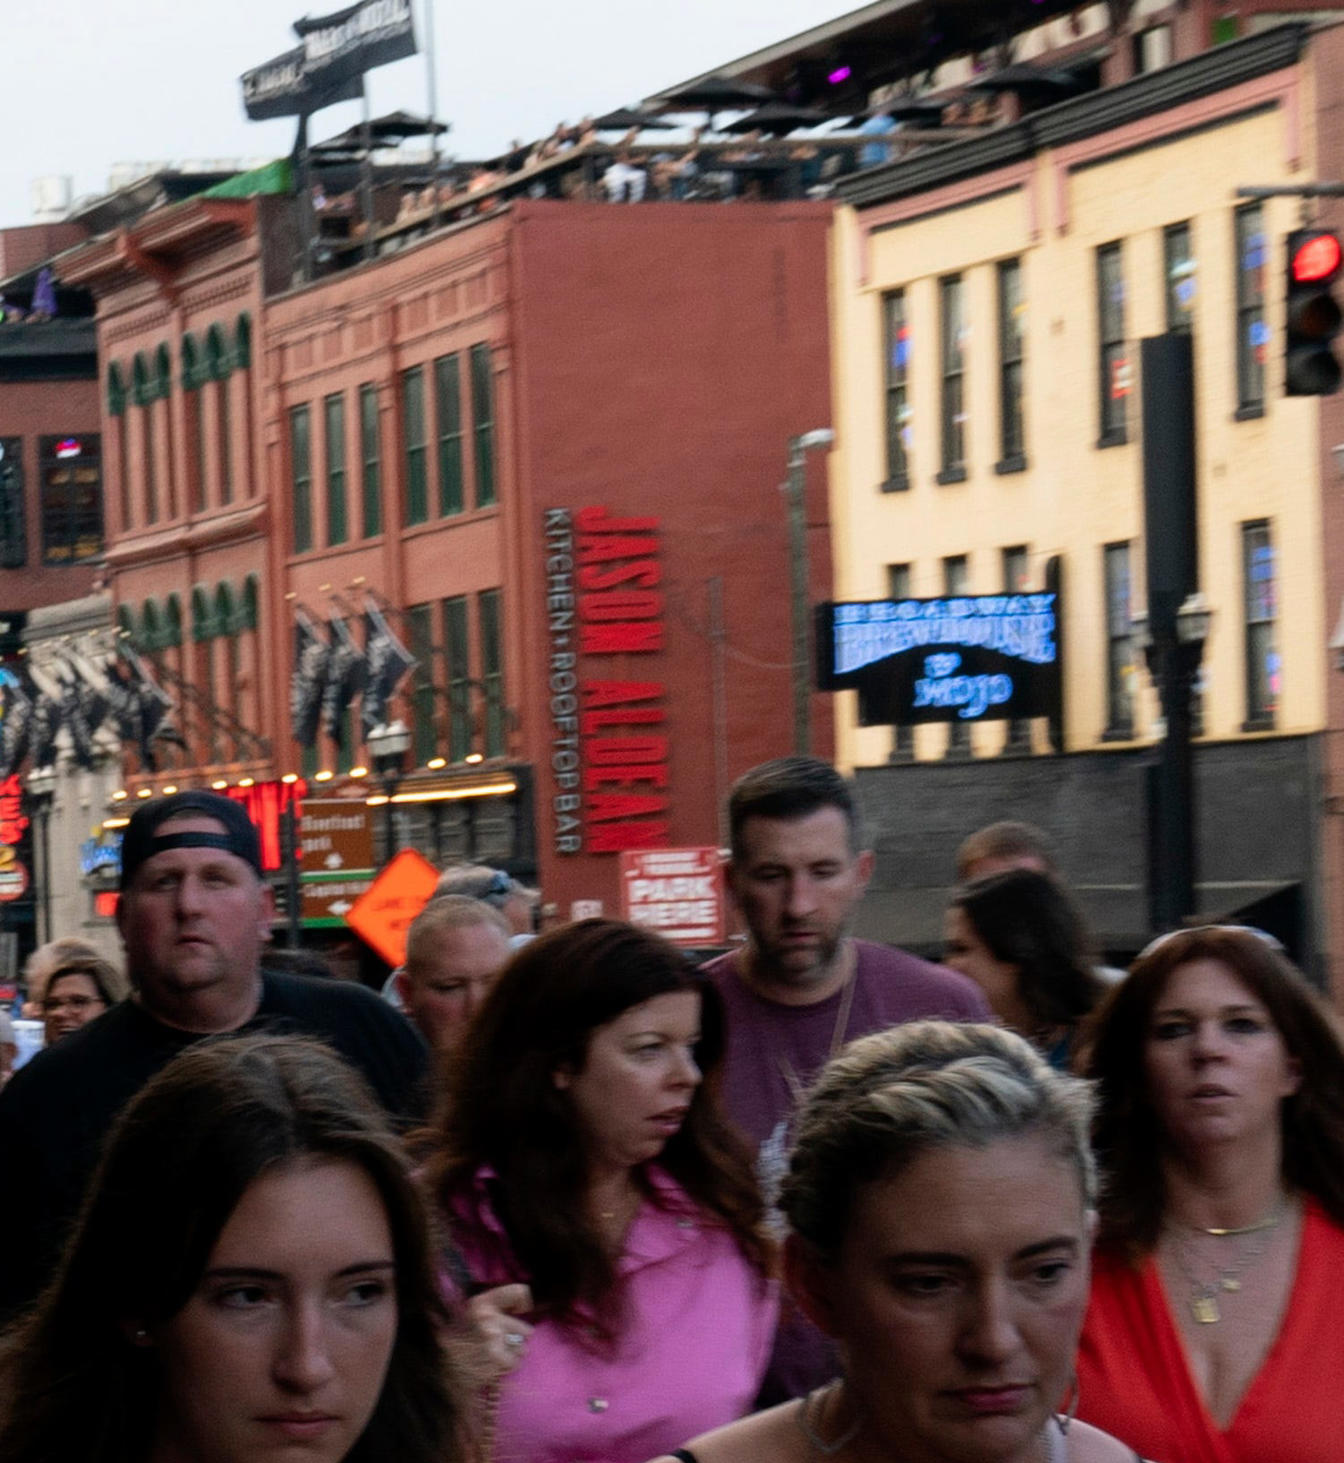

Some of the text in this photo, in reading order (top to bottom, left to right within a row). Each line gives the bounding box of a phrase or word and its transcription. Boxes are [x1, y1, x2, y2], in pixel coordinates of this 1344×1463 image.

[544, 506, 575, 633] KITCHEN
[574, 505, 666, 654] JASON
[548, 650, 581, 791] ROOFTOP
[583, 679, 671, 854] ALDEAN
[552, 793, 582, 854] BAR
[628, 876, 724, 904] PARK
[629, 901, 725, 927] HERE
